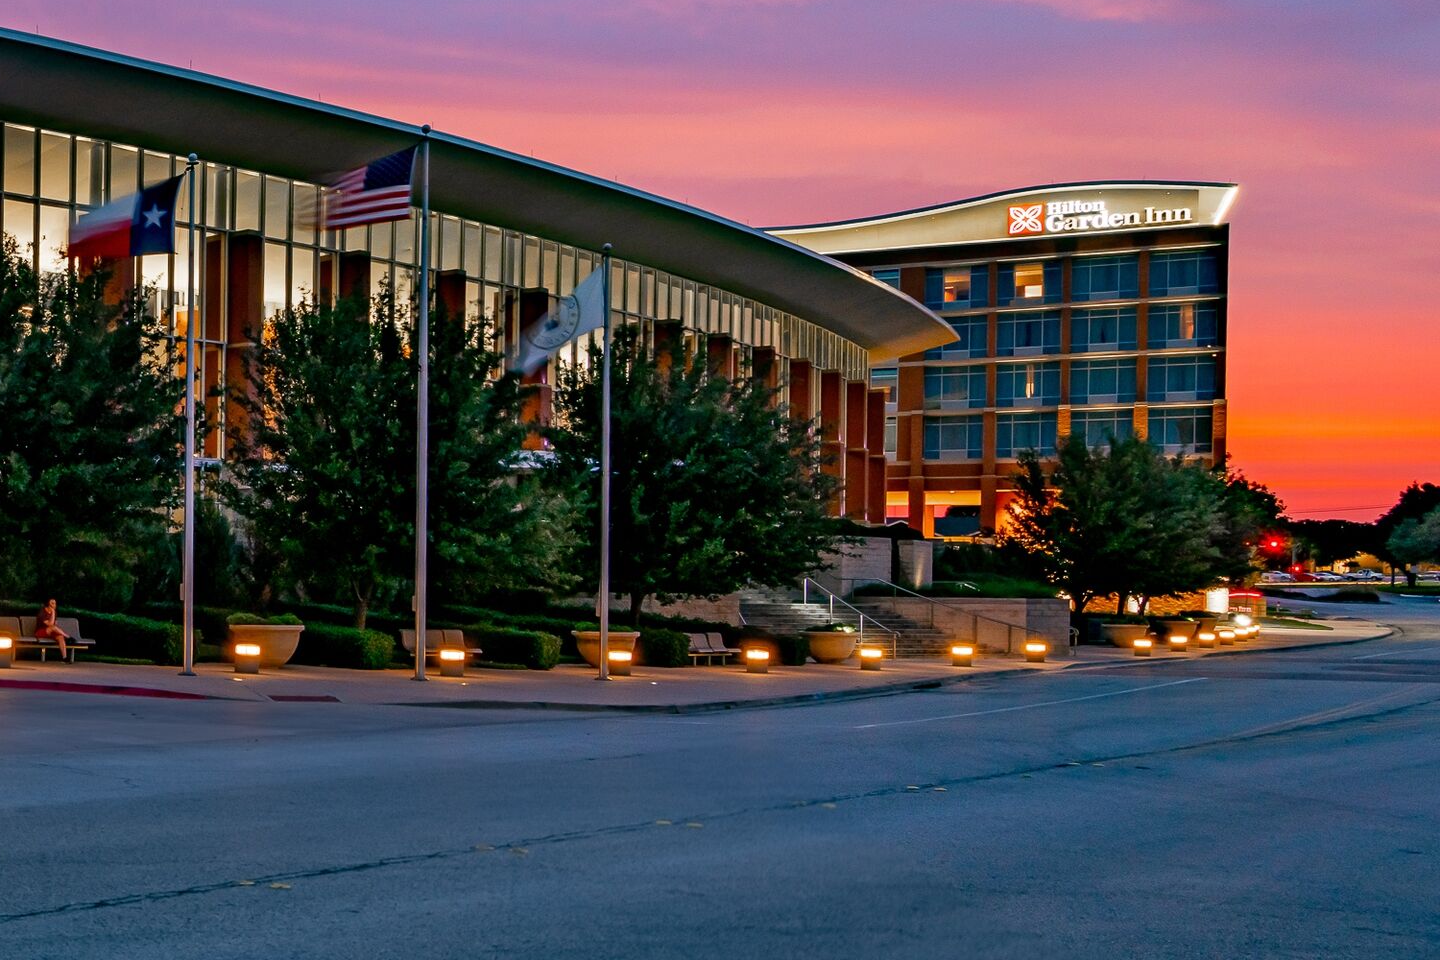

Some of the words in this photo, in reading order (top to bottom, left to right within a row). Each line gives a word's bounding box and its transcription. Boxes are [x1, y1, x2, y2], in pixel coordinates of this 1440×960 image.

[1046, 200, 1105, 215] Hilton
[1045, 210, 1141, 232] Garden
[1144, 206, 1193, 224] Inn
